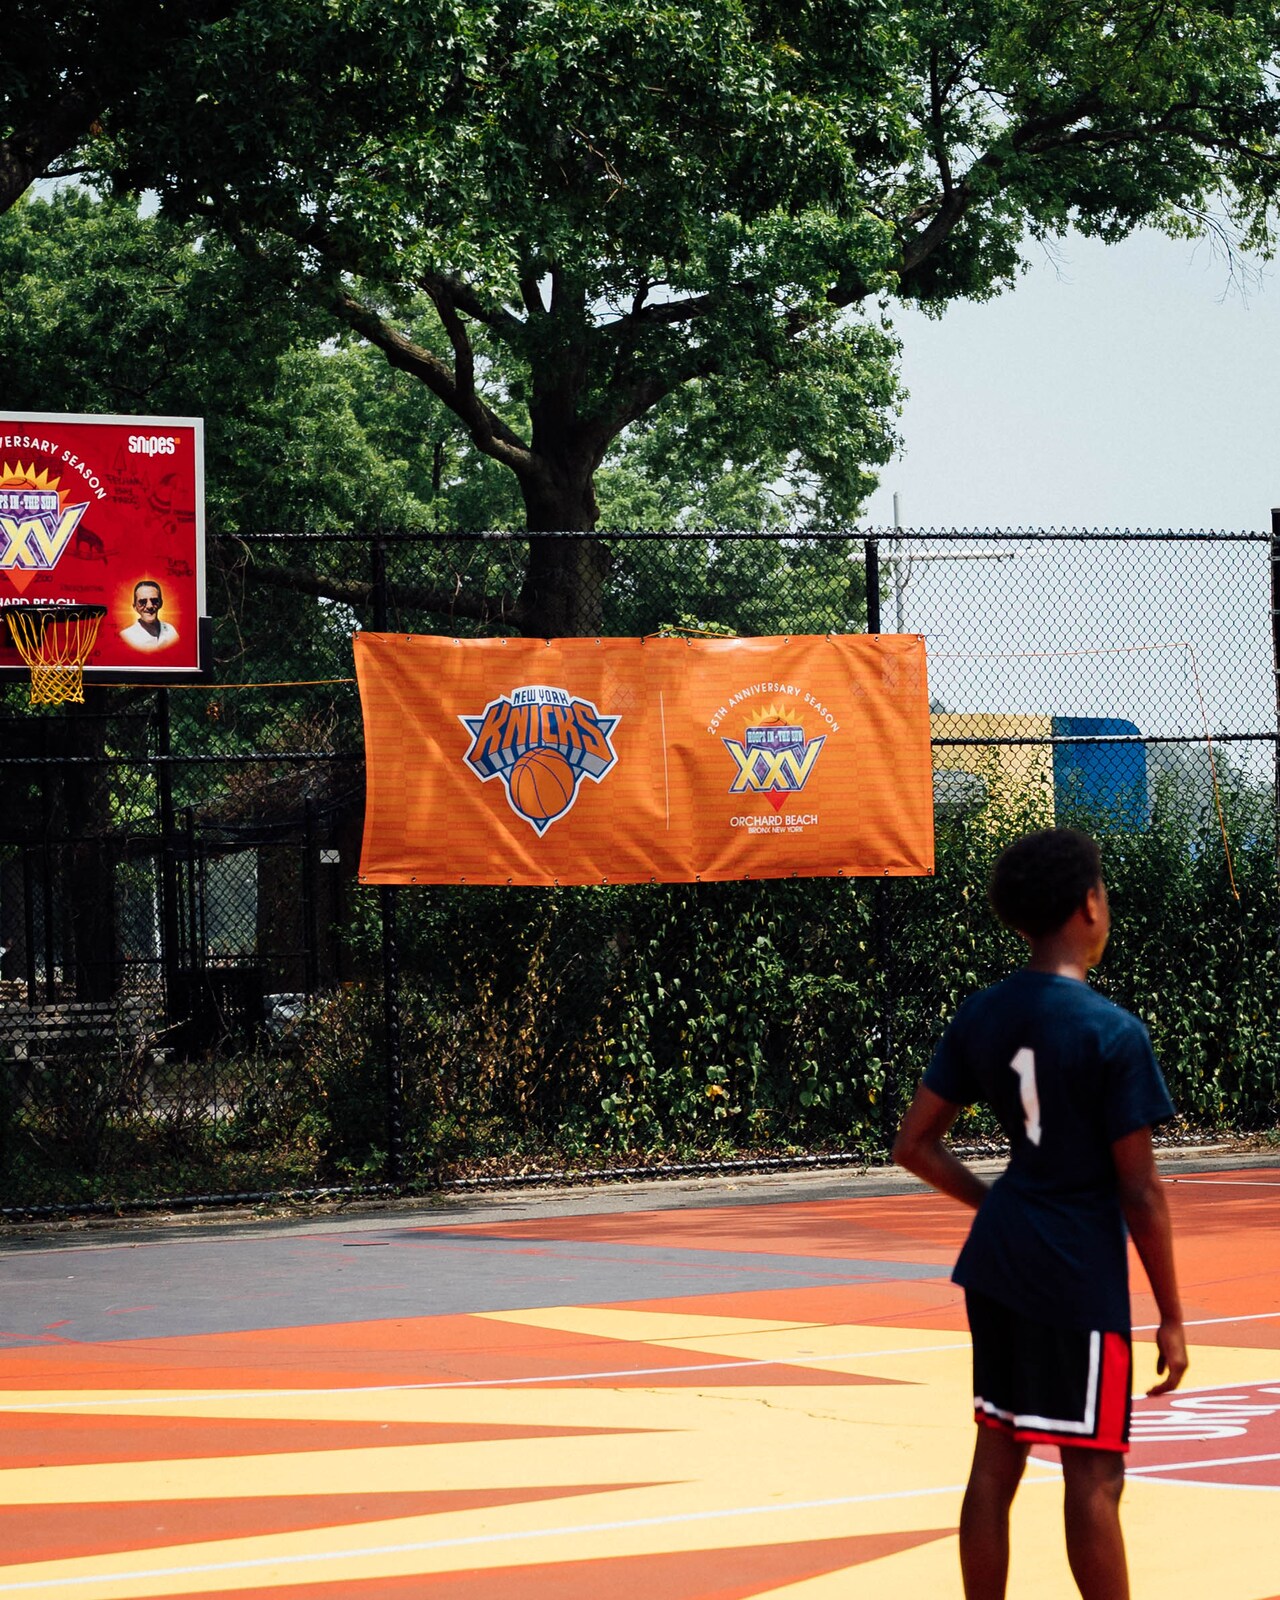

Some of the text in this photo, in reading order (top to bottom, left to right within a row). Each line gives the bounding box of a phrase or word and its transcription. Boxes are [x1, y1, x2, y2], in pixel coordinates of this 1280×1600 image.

[128, 435, 175, 457] snipes
[61, 450, 107, 499] SEASON
[513, 689, 569, 705] NEW YORK
[706, 682, 840, 735] 25TH ANNIVERSARY SEASON
[467, 699, 614, 770] KNICKS
[721, 734, 827, 793] XXV
[729, 814, 818, 828] ORCHARD BEACH
[747, 825, 804, 835] BRONX NEW YORK
[1009, 1046, 1043, 1147] 1
